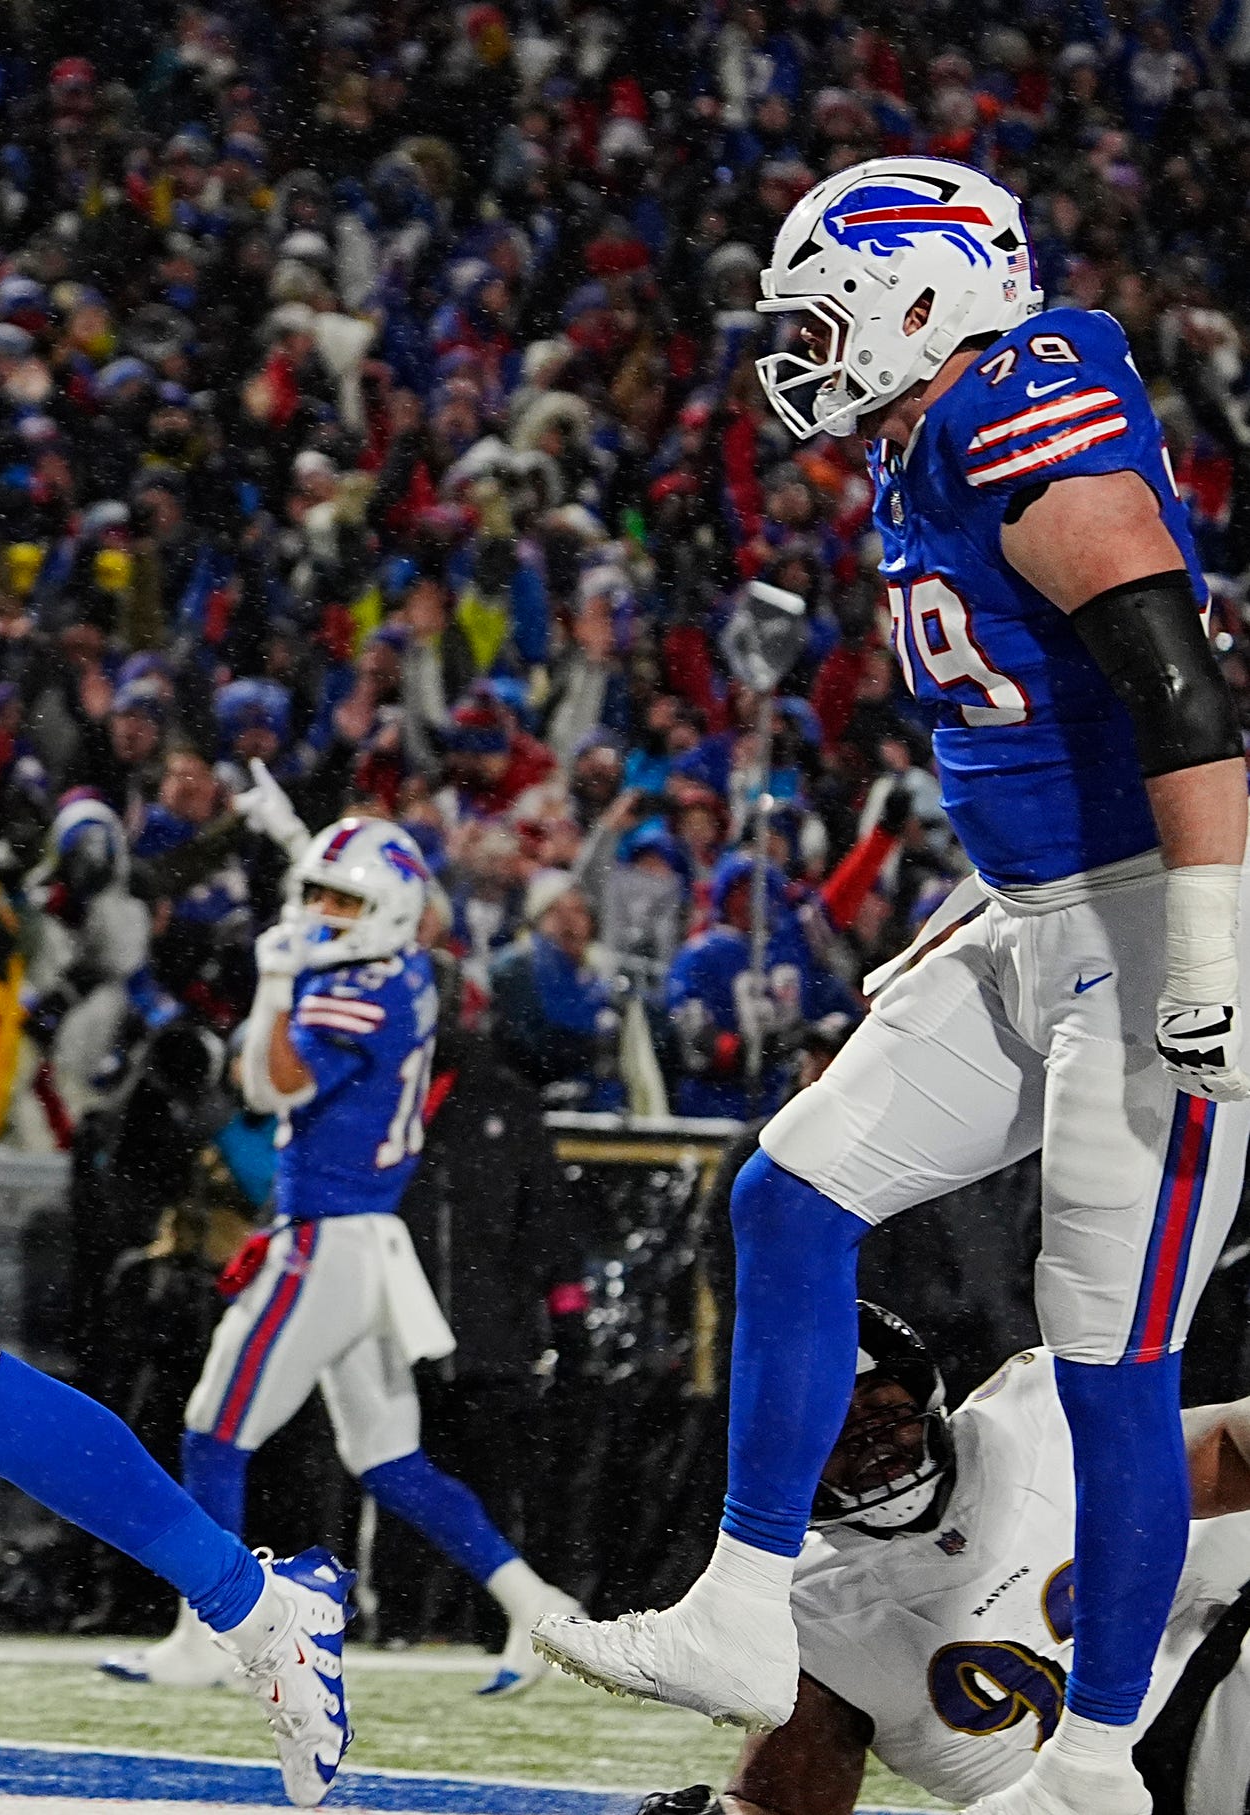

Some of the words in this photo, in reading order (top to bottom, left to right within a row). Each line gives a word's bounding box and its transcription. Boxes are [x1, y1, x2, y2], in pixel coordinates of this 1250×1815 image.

[978, 333, 1081, 387] 79
[971, 1565, 1030, 1616] RAVENS
[927, 1557, 1075, 1753] 9
